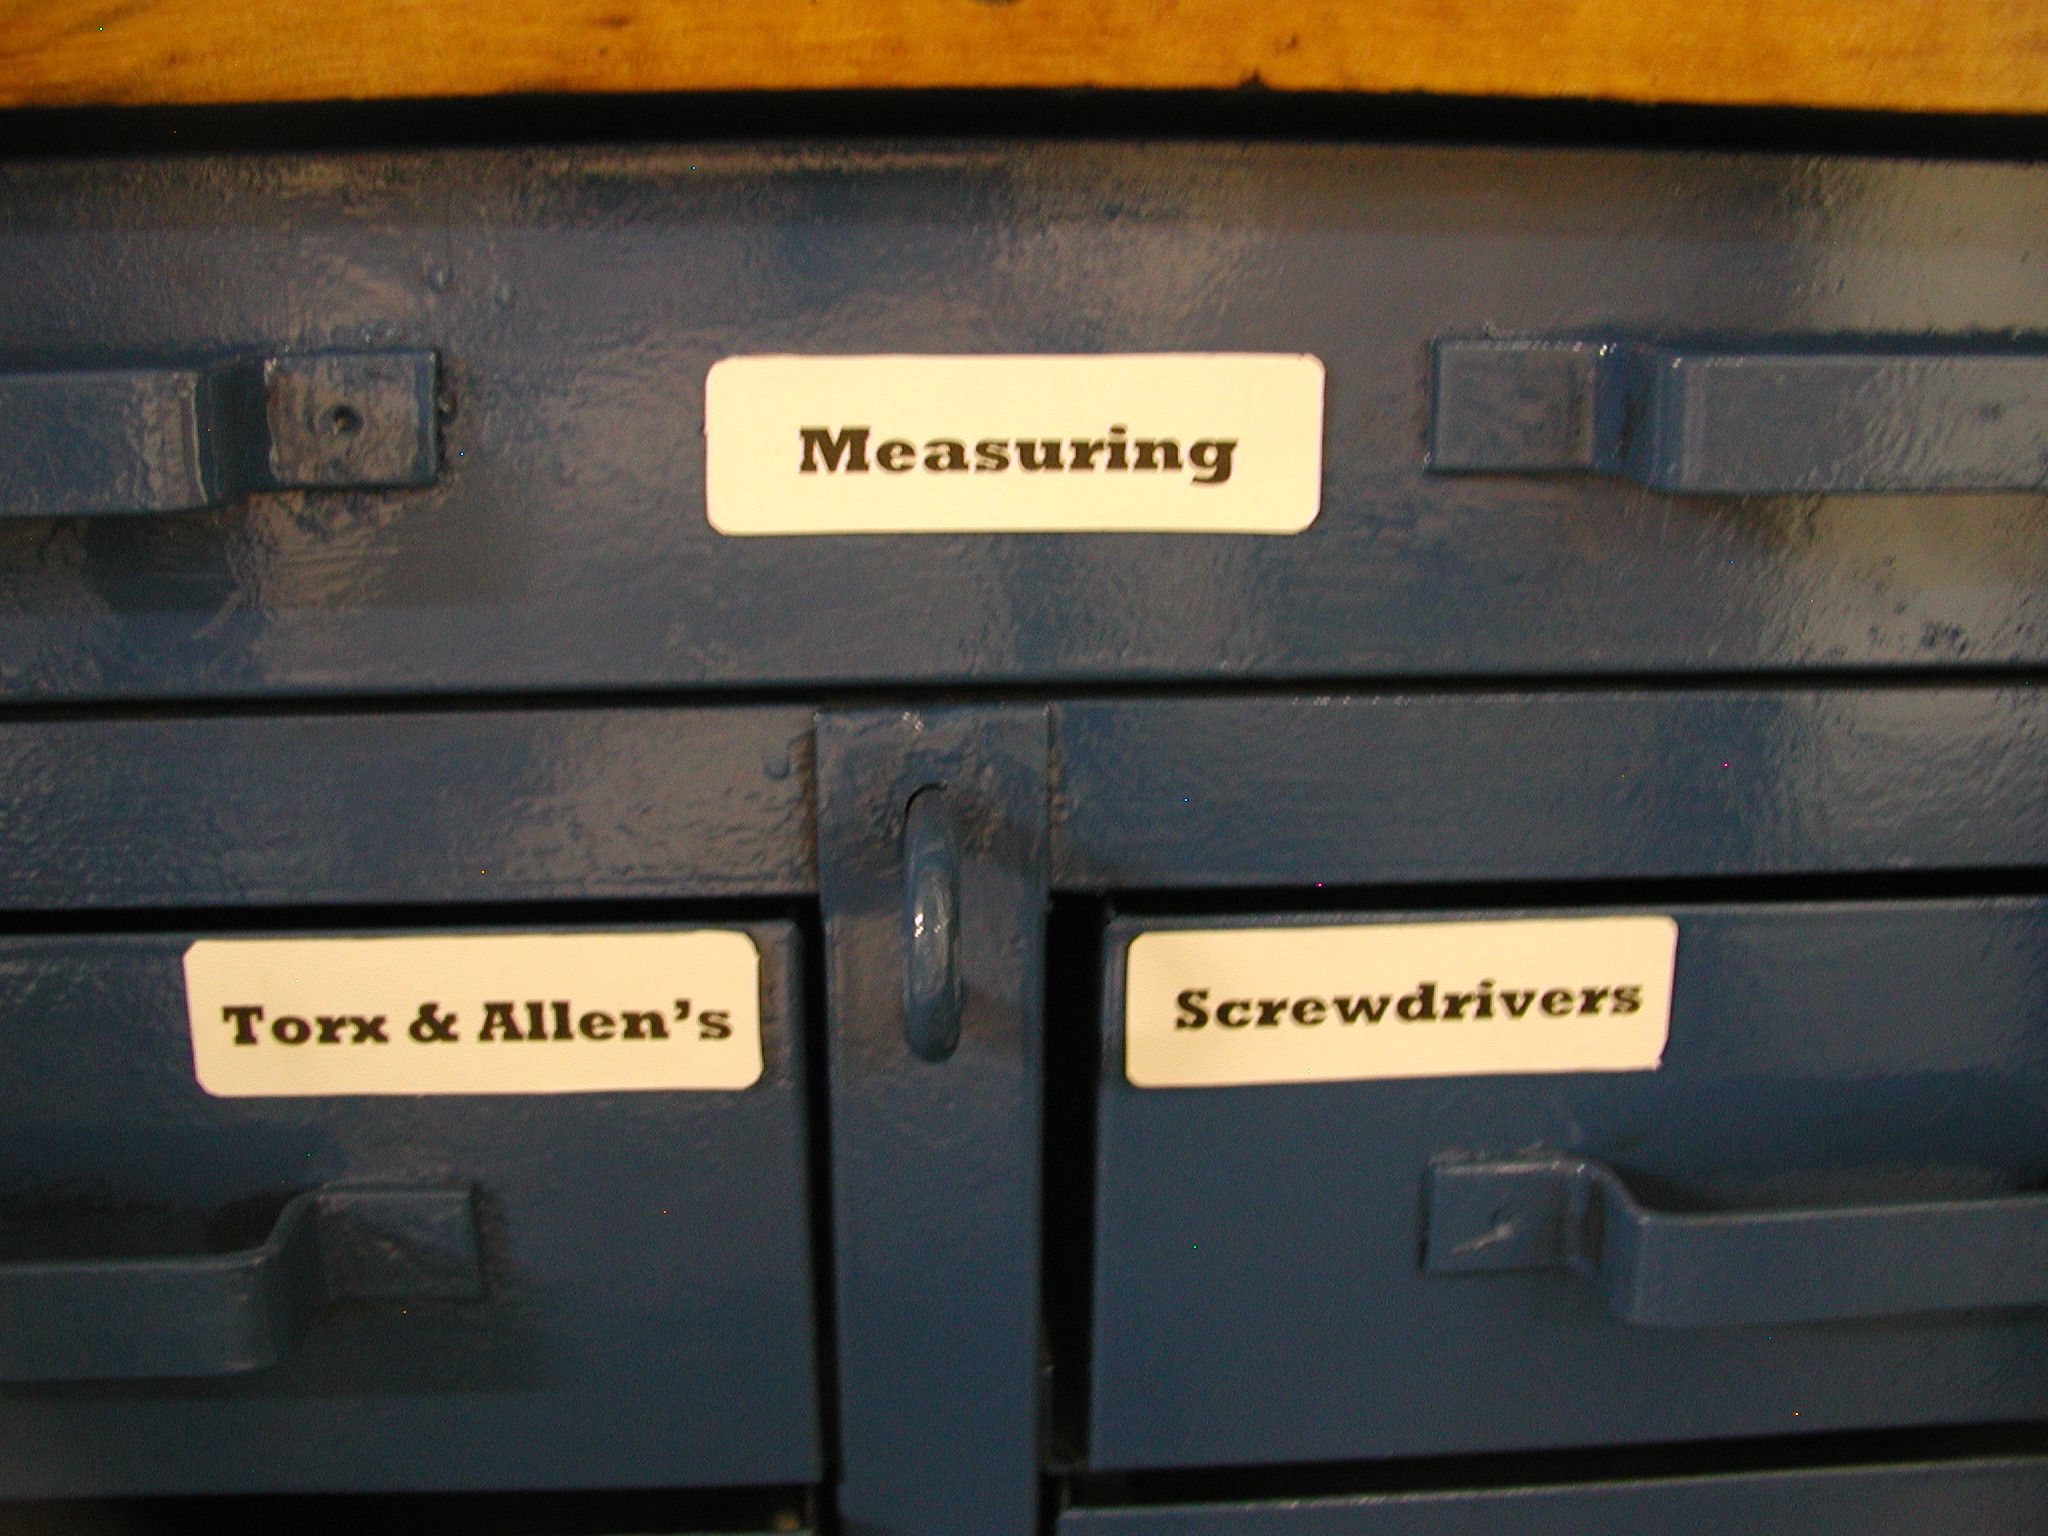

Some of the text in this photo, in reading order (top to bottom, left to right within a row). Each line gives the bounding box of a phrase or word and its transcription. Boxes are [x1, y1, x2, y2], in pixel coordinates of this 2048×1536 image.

[799, 424, 1237, 485] Measuring
[220, 998, 733, 1047] Torx & Allen's
[1174, 980, 1642, 1031] Screwdrivers
